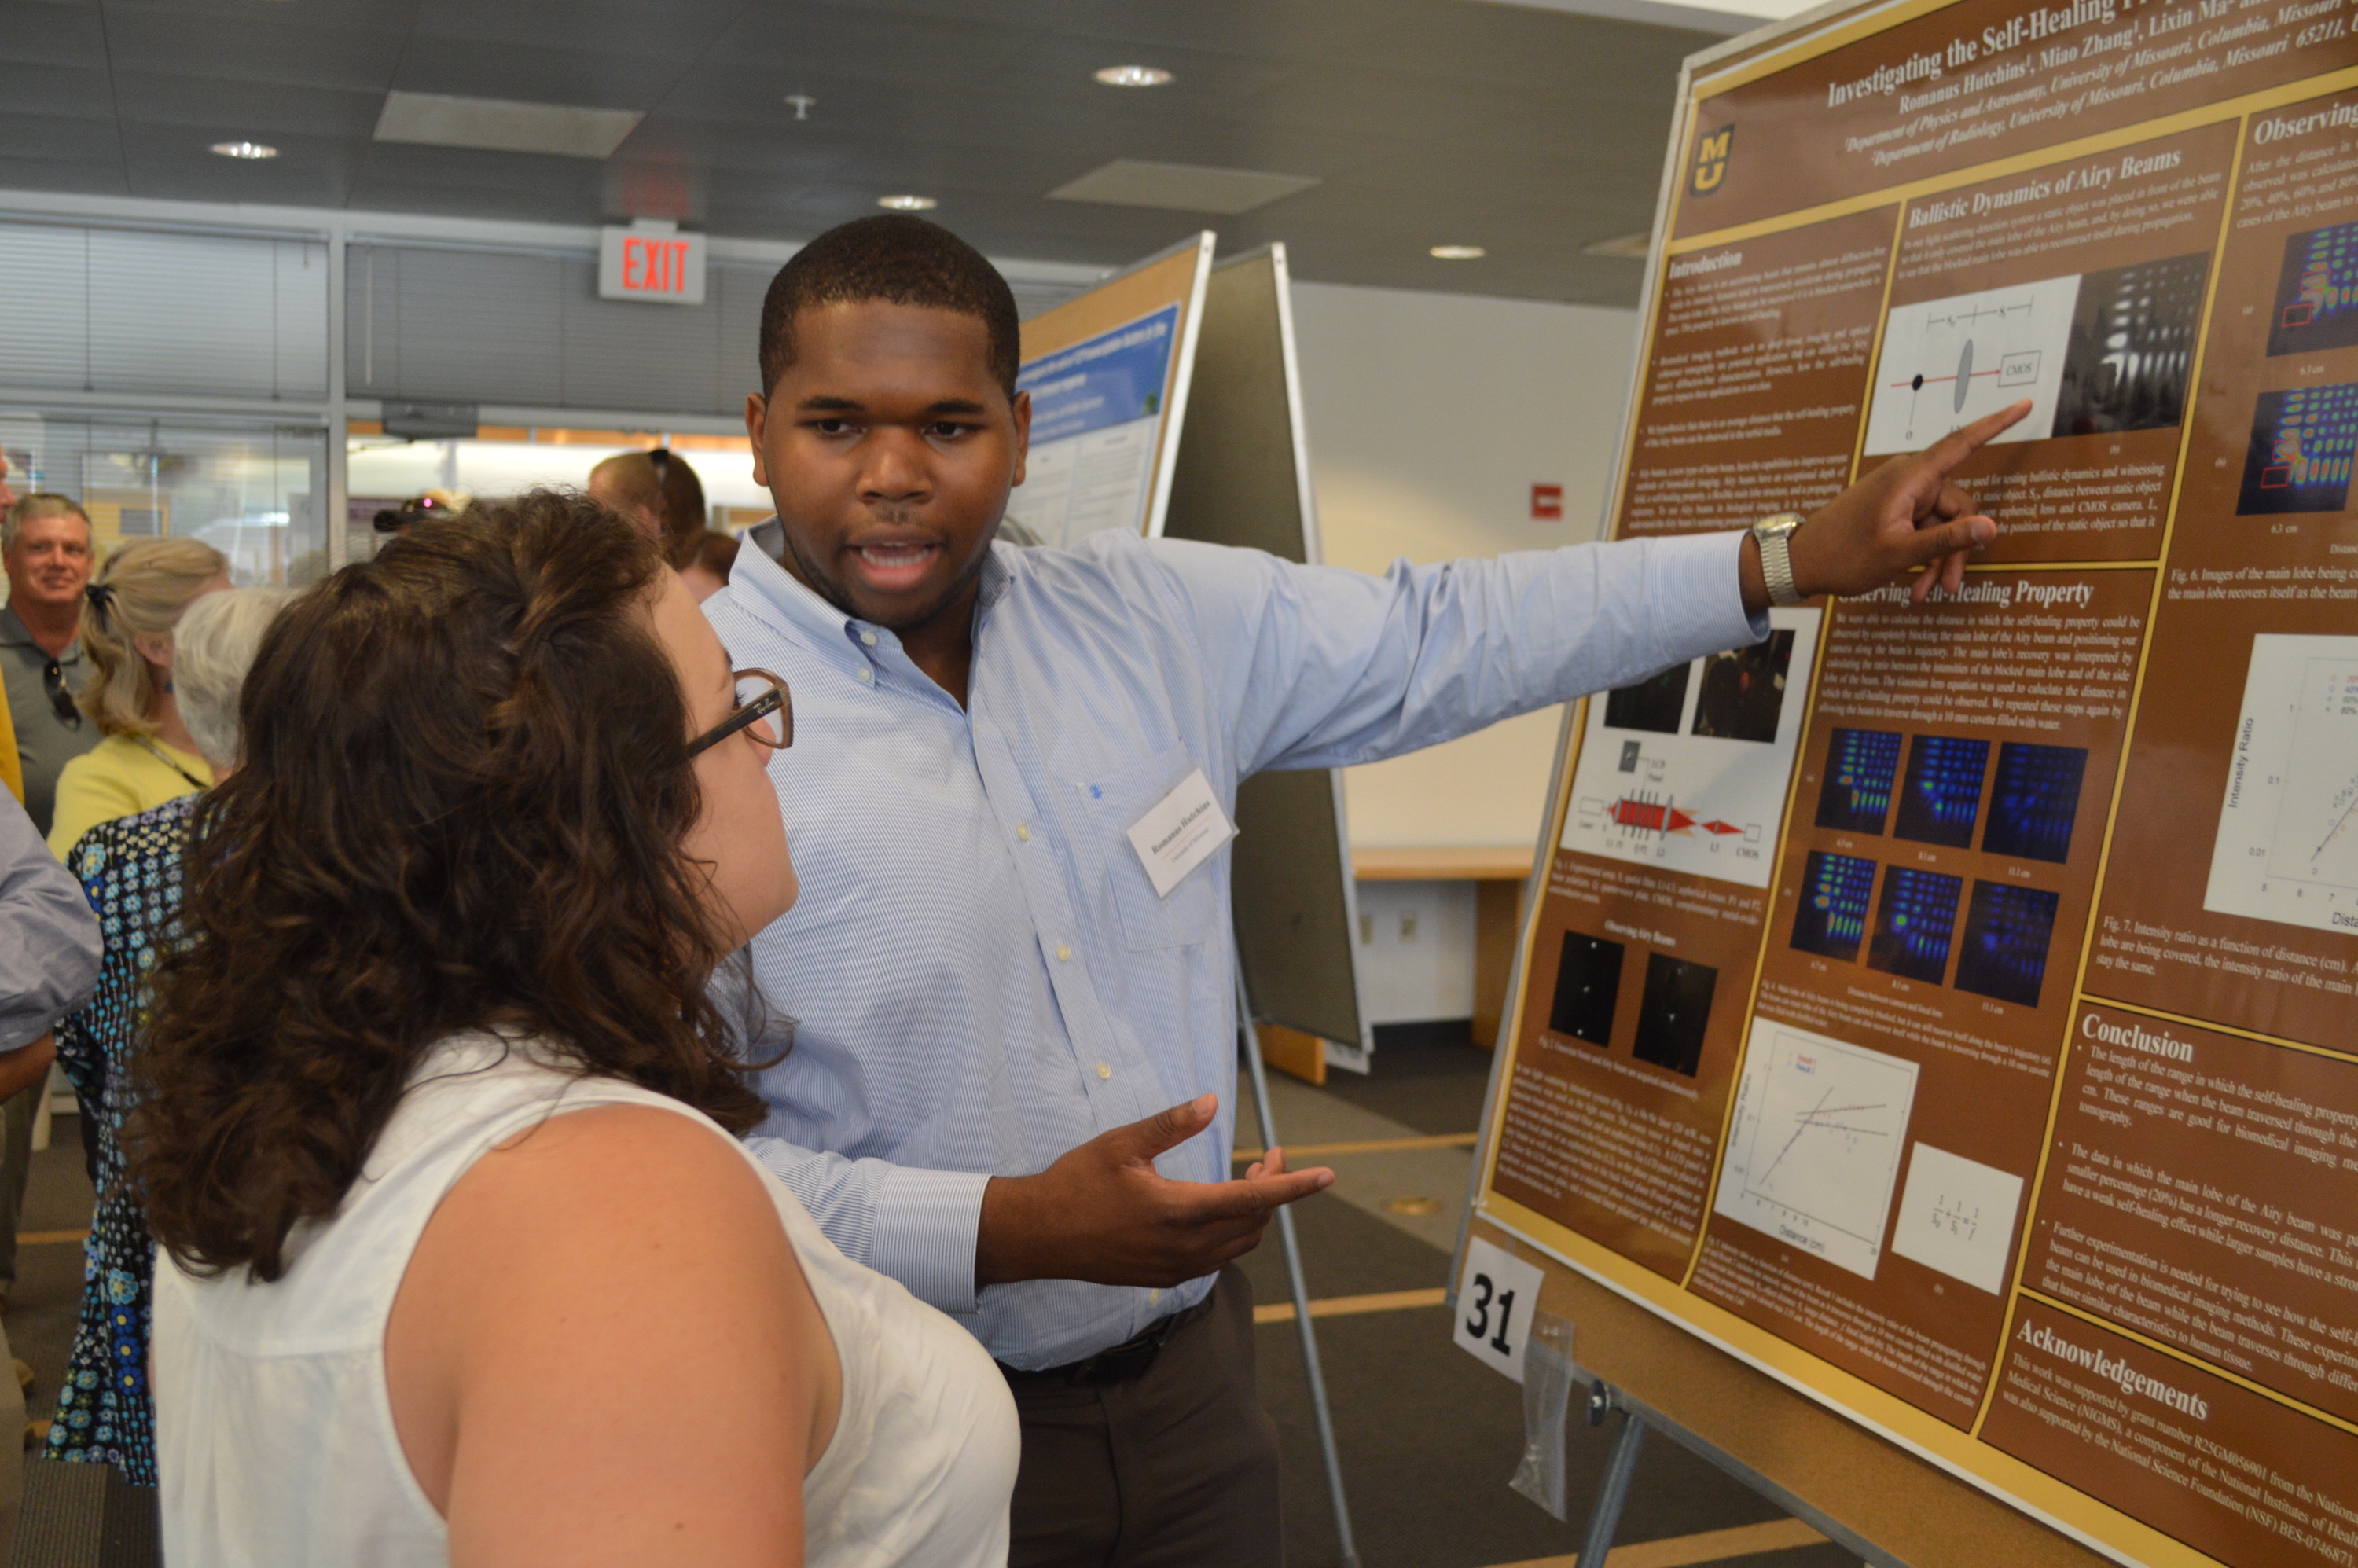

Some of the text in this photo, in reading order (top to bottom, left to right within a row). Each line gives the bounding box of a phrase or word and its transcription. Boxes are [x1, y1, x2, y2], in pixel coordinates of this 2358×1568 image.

[1828, 0, 2115, 108] Investigating the Self-Healing
[1899, 83, 1959, 114] Romanus
[2040, 46, 2077, 70] Miao
[2149, 8, 2192, 36] Lixin
[1906, 116, 1920, 138] of
[1919, 108, 1957, 132] Physics
[1960, 98, 1984, 119] and
[2051, 63, 2113, 93] University
[2114, 54, 2132, 75] of
[1934, 130, 1950, 152] of
[2009, 101, 2068, 128] University
[2070, 92, 2087, 113] of
[2223, 35, 2290, 68] Missouri
[1909, 151, 2180, 229] Ballistic Dynamics of Airy Beams
[623, 237, 691, 294] EXIT
[1669, 251, 1743, 280] Introduction
[2014, 582, 2093, 608] Property
[2167, 586, 2181, 600] the
[2182, 586, 2204, 599] main
[2206, 586, 2226, 599] lobe
[2228, 589, 2268, 599] recovers
[2269, 586, 2296, 599] itself
[2296, 589, 2308, 599] as
[2309, 586, 2327, 599] the
[2201, 568, 2233, 584] Images
[2235, 567, 2248, 580] of
[2248, 567, 2264, 580] the
[2264, 566, 2290, 579] main
[2293, 566, 2315, 579] lobe
[2317, 566, 2346, 582] being
[2228, 718, 2253, 808] Intensity Ratio
[1151, 826, 1182, 855] Romanus
[1181, 800, 1211, 828] Hutchins
[2096, 953, 2112, 970] stay
[2114, 955, 2129, 970] the
[2099, 932, 2119, 949] lobe
[2120, 939, 2135, 953] are
[2136, 939, 2161, 960] being
[2204, 953, 2220, 969] the
[2222, 956, 2263, 981] intensity
[2265, 967, 2289, 982] ratio
[2291, 971, 2305, 986] of
[2305, 973, 2323, 989] the
[2324, 979, 2352, 995] main
[2134, 920, 2171, 943] Intensity
[2174, 929, 2196, 945] ratio
[2198, 935, 2208, 947] as
[2209, 937, 2217, 949] a
[2219, 935, 2259, 957] function
[2261, 945, 2276, 960] of
[2275, 946, 2318, 968] distance
[2082, 1012, 2193, 1063] Conclusion
[2091, 1044, 2106, 1061] The
[2108, 1048, 2136, 1070] length
[2138, 1058, 2151, 1073] of
[2150, 1060, 2165, 1077] the
[2167, 1067, 2194, 1086] range
[2195, 1071, 2206, 1087] in
[2208, 1077, 2235, 1095] which
[2238, 1084, 2254, 1100] the
[2256, 1090, 2312, 1118] self-healing
[2072, 1141, 2343, 1243] The data in which the main lobe of the Airy beam was
[1466, 1272, 1515, 1357] 31
[2016, 1315, 2208, 1420] Acknowledgements
[2003, 1390, 2018, 1407] was
[2018, 1396, 2037, 1416] also
[2037, 1405, 2080, 1435] supported
[2081, 1423, 2094, 1445] by
[2094, 1430, 2110, 1450] the
[2111, 1438, 2150, 1470] National
[2150, 1456, 2188, 1488] Science
[2190, 1476, 2245, 1515] Foundation
[2245, 1503, 2277, 1535] (NSF)
[2007, 1368, 2042, 1397] Medical
[2043, 1385, 2076, 1412] Science
[2125, 1426, 2132, 1439] a
[2134, 1430, 2185, 1464] component
[2187, 1456, 2202, 1473] of
[2202, 1461, 2217, 1480] the
[2220, 1468, 2261, 1501] National
[2262, 1489, 2308, 1525] Institutes
[2311, 1517, 2328, 1534] of
[2013, 1352, 2029, 1372] This
[2032, 1364, 2052, 1383] work
[2055, 1374, 2071, 1390] was
[2073, 1381, 2116, 1411] supported
[2117, 1399, 2129, 1420] by
[2131, 1408, 2157, 1430] grant
[2156, 1419, 2193, 1446] number
[2269, 1470, 2295, 1494] from
[2297, 1484, 2315, 1504] the
